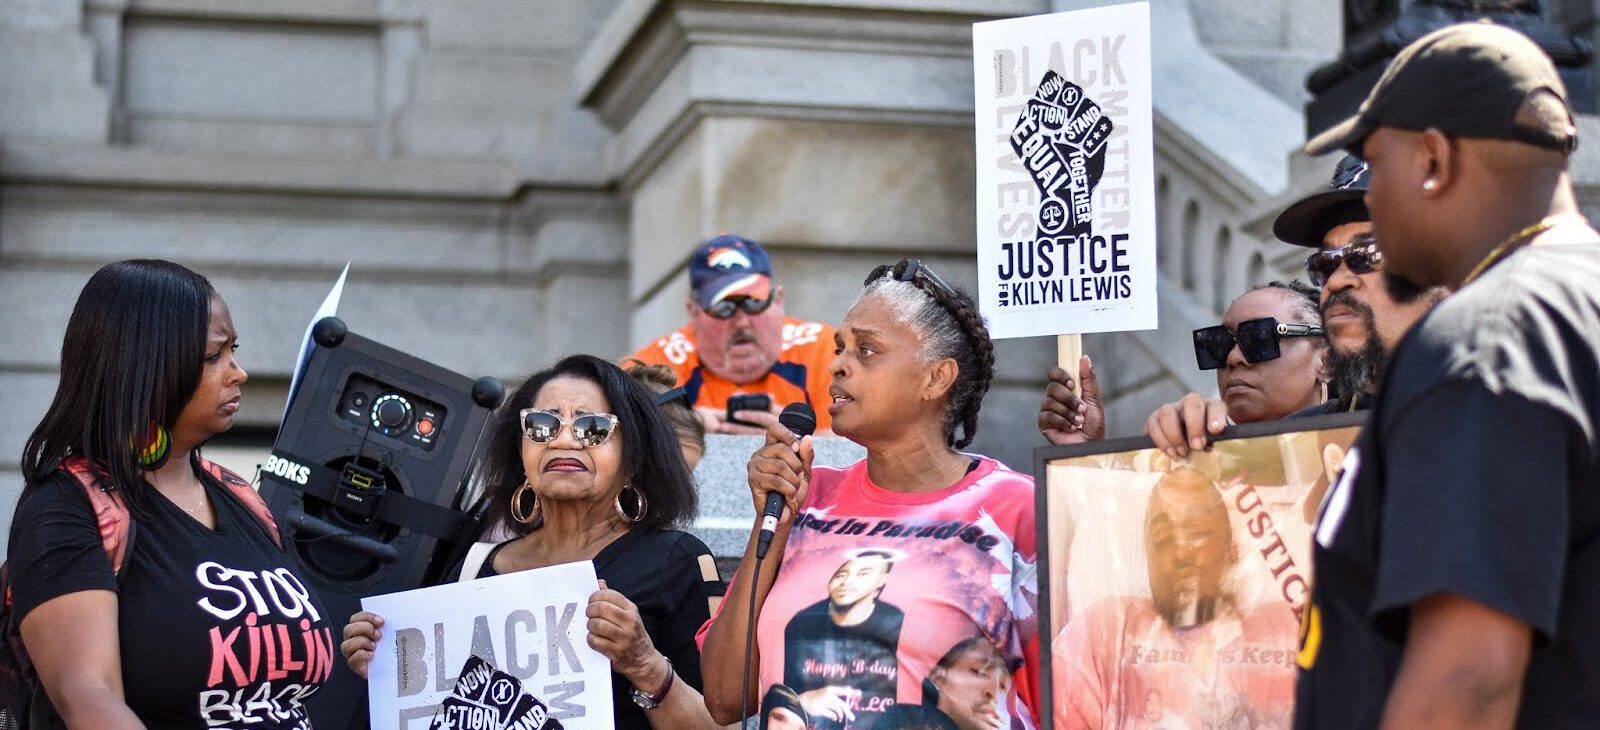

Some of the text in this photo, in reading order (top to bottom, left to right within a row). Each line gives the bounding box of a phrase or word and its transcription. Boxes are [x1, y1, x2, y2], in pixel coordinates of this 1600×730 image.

[994, 35, 1128, 99] BLACK
[1038, 74, 1064, 100] NOW
[1021, 105, 1068, 125] ACTION
[1065, 105, 1101, 140] STAND
[996, 104, 1036, 238] LIVES
[1012, 117, 1069, 197] EQUAL
[1098, 90, 1131, 231] MATTER
[1068, 150, 1092, 225] TOGETHER
[998, 283, 1009, 307] FOR
[1012, 274, 1131, 306] KILYN LEWIS
[834, 518, 870, 535] In
[866, 520, 1000, 551] Paradise
[196, 561, 321, 623] STOP
[395, 602, 585, 698] BLACK
[802, 658, 896, 680] Happy B-day
[457, 661, 491, 698] NOW
[199, 681, 320, 727] BLACK
